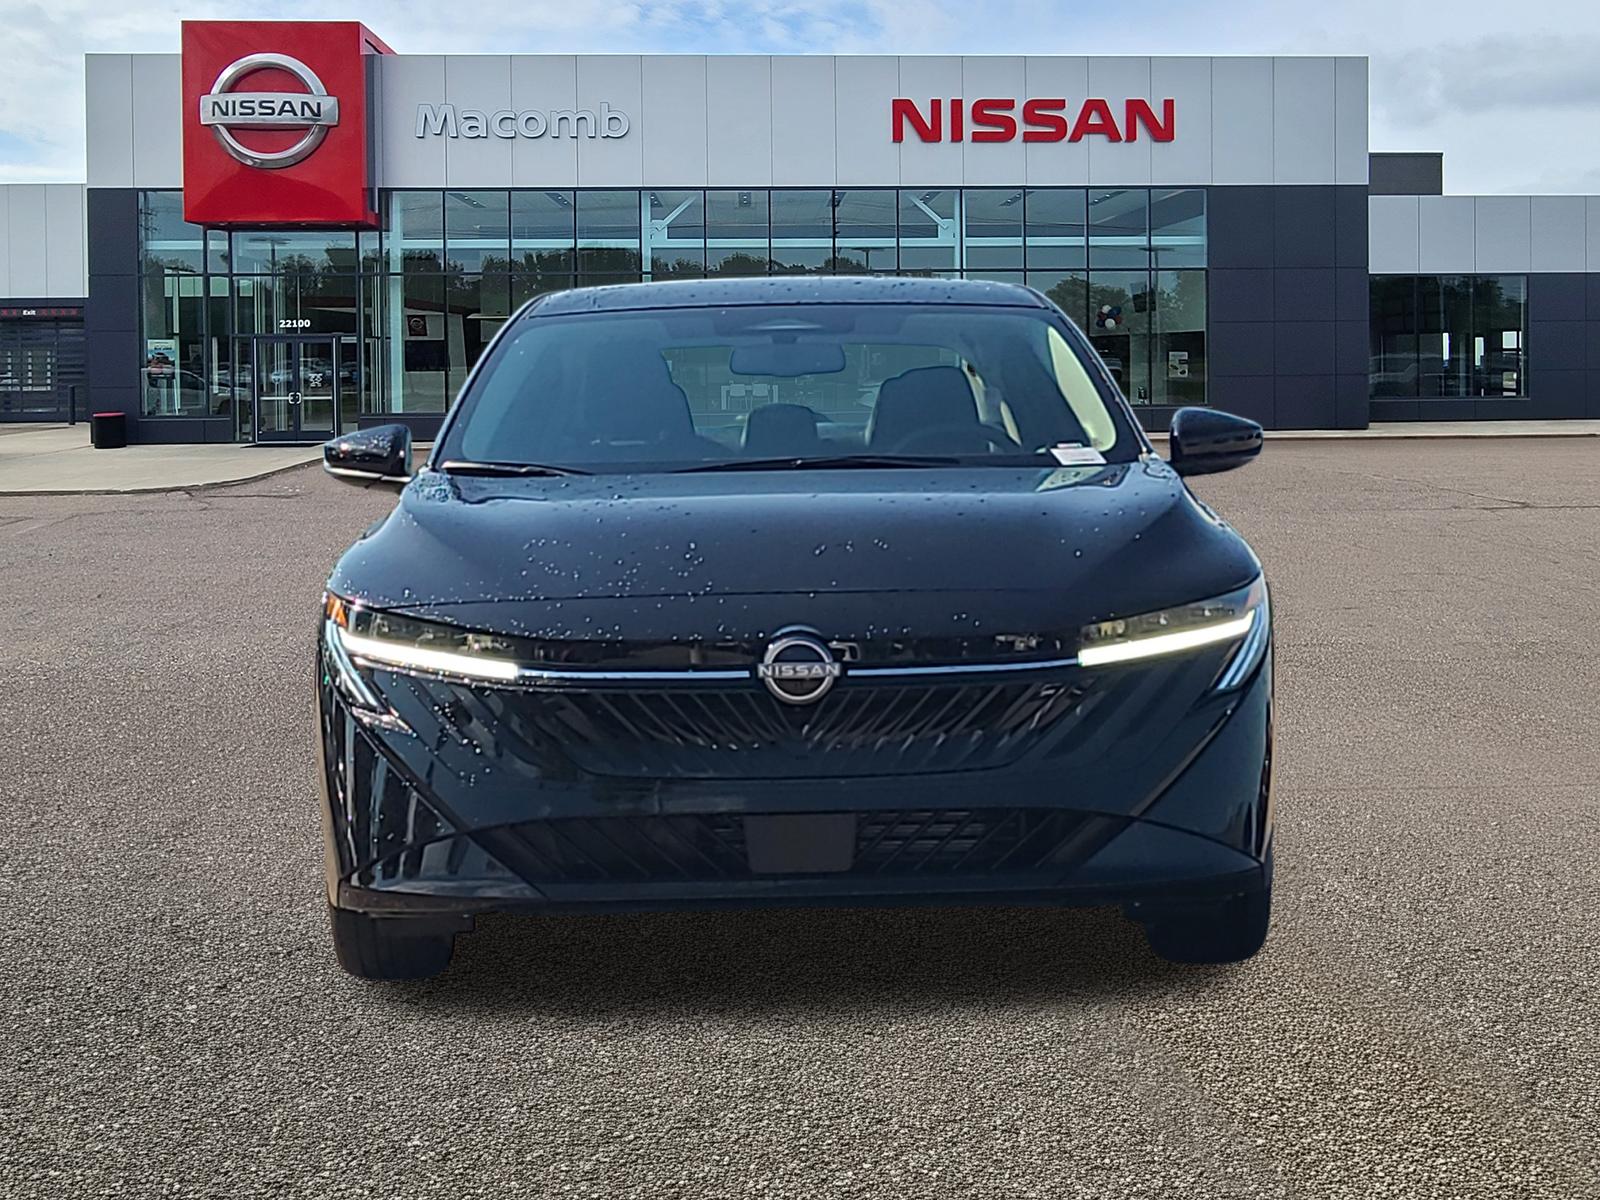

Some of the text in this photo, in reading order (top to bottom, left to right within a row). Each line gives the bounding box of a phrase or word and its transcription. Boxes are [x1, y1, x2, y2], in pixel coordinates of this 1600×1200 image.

[212, 100, 321, 117] NISSAN
[415, 102, 630, 138] Macomb
[892, 98, 1175, 143] NISSAN
[279, 319, 311, 328] 22100
[759, 664, 839, 677] NISSAN
